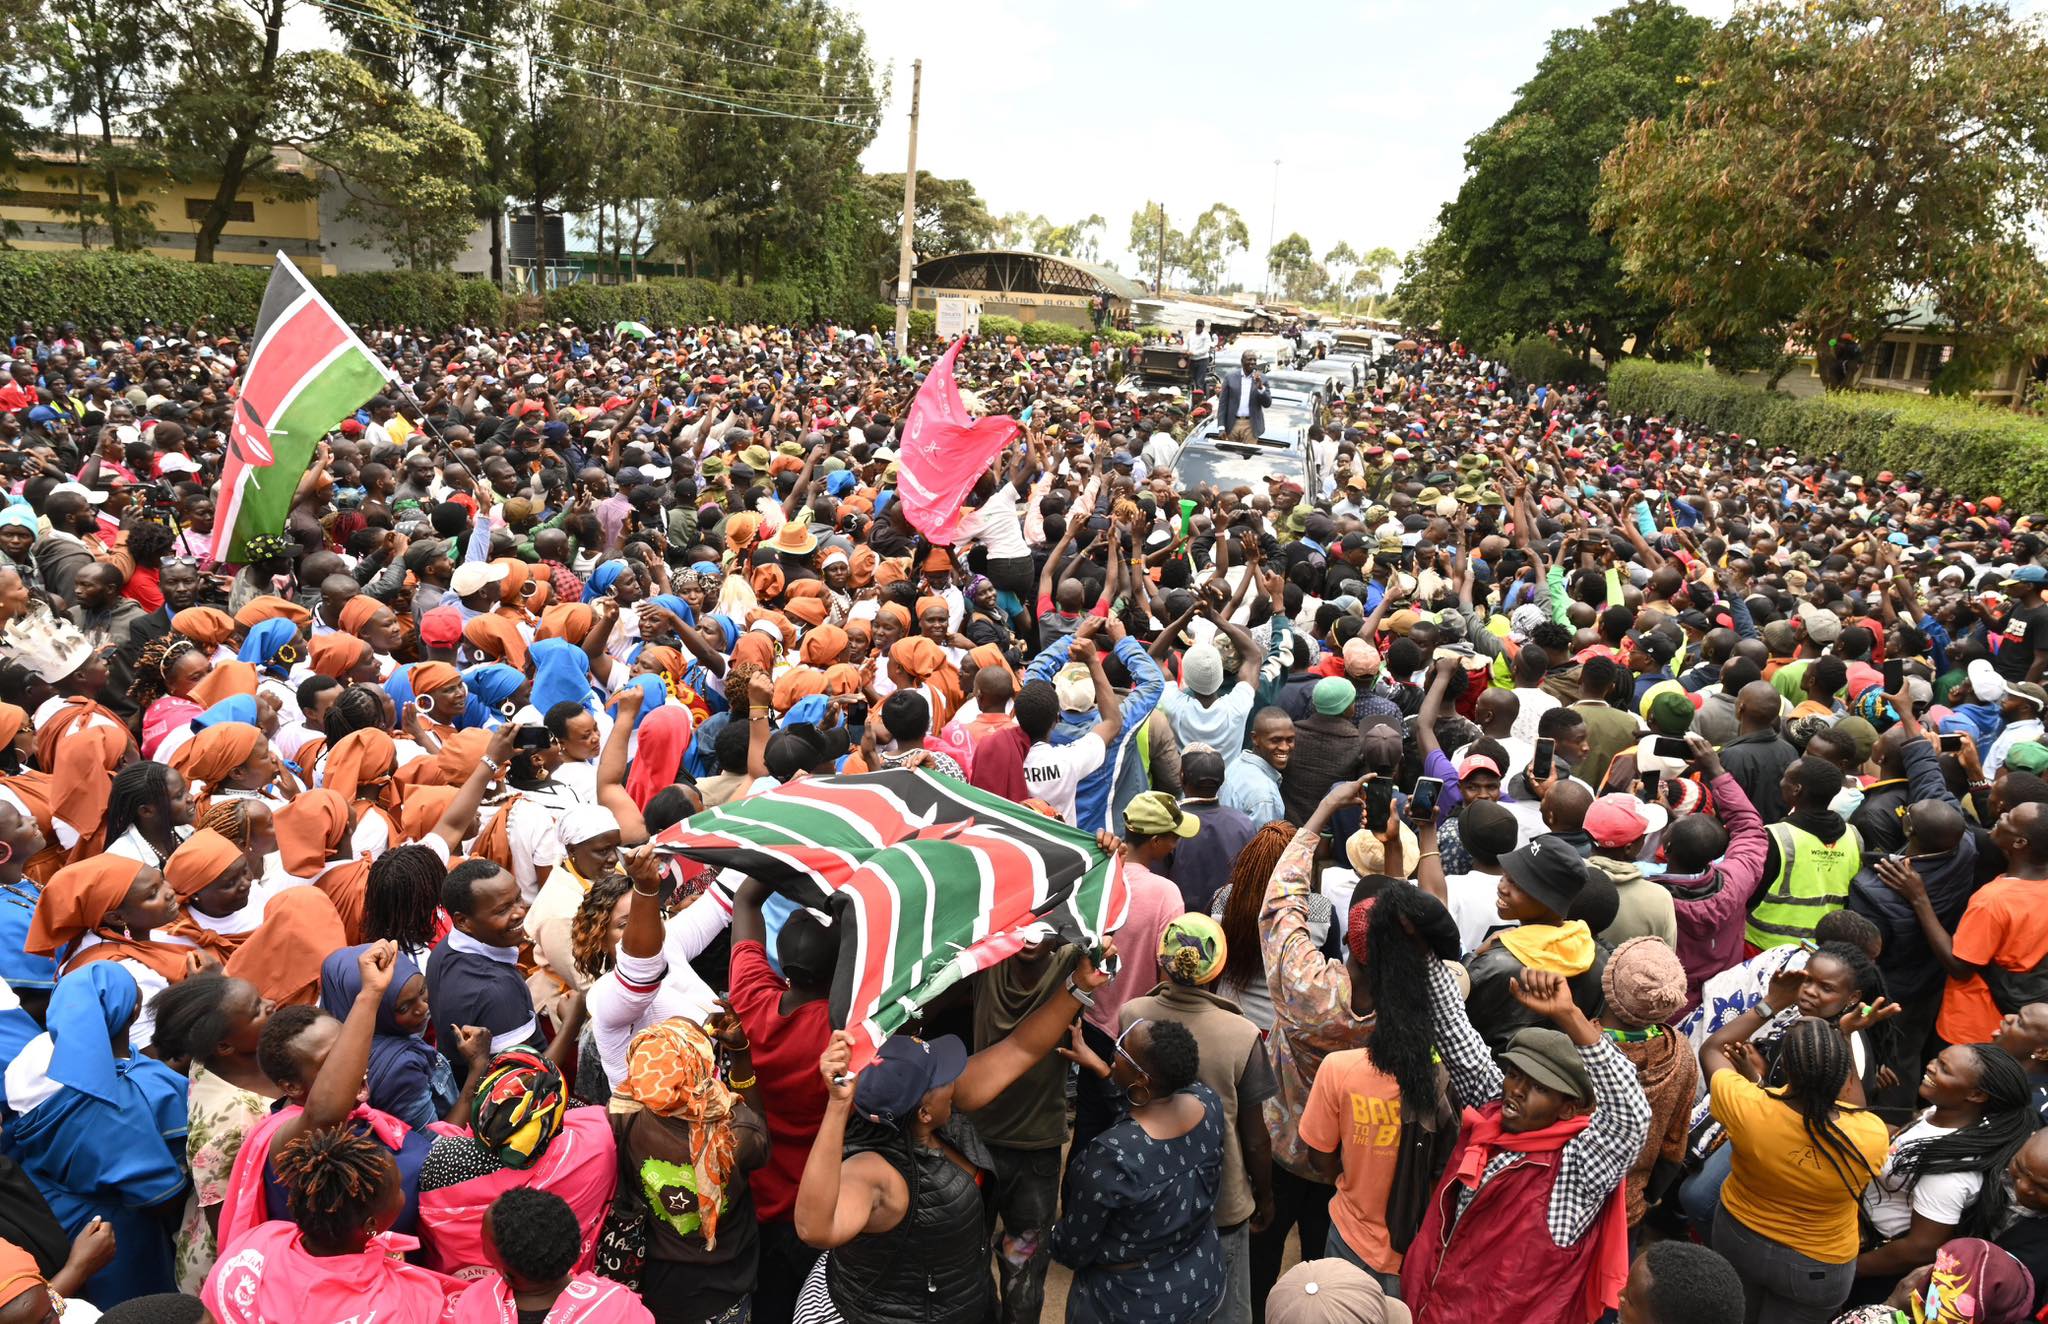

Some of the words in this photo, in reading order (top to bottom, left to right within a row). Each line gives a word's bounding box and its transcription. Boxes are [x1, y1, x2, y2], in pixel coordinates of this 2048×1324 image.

[1044, 298, 1075, 306] BLOCK
[1353, 1123, 1369, 1136] TO
[1353, 1135, 1369, 1145] THE
[1374, 1125, 1400, 1146] B
[463, 1269, 488, 1279] JANE
